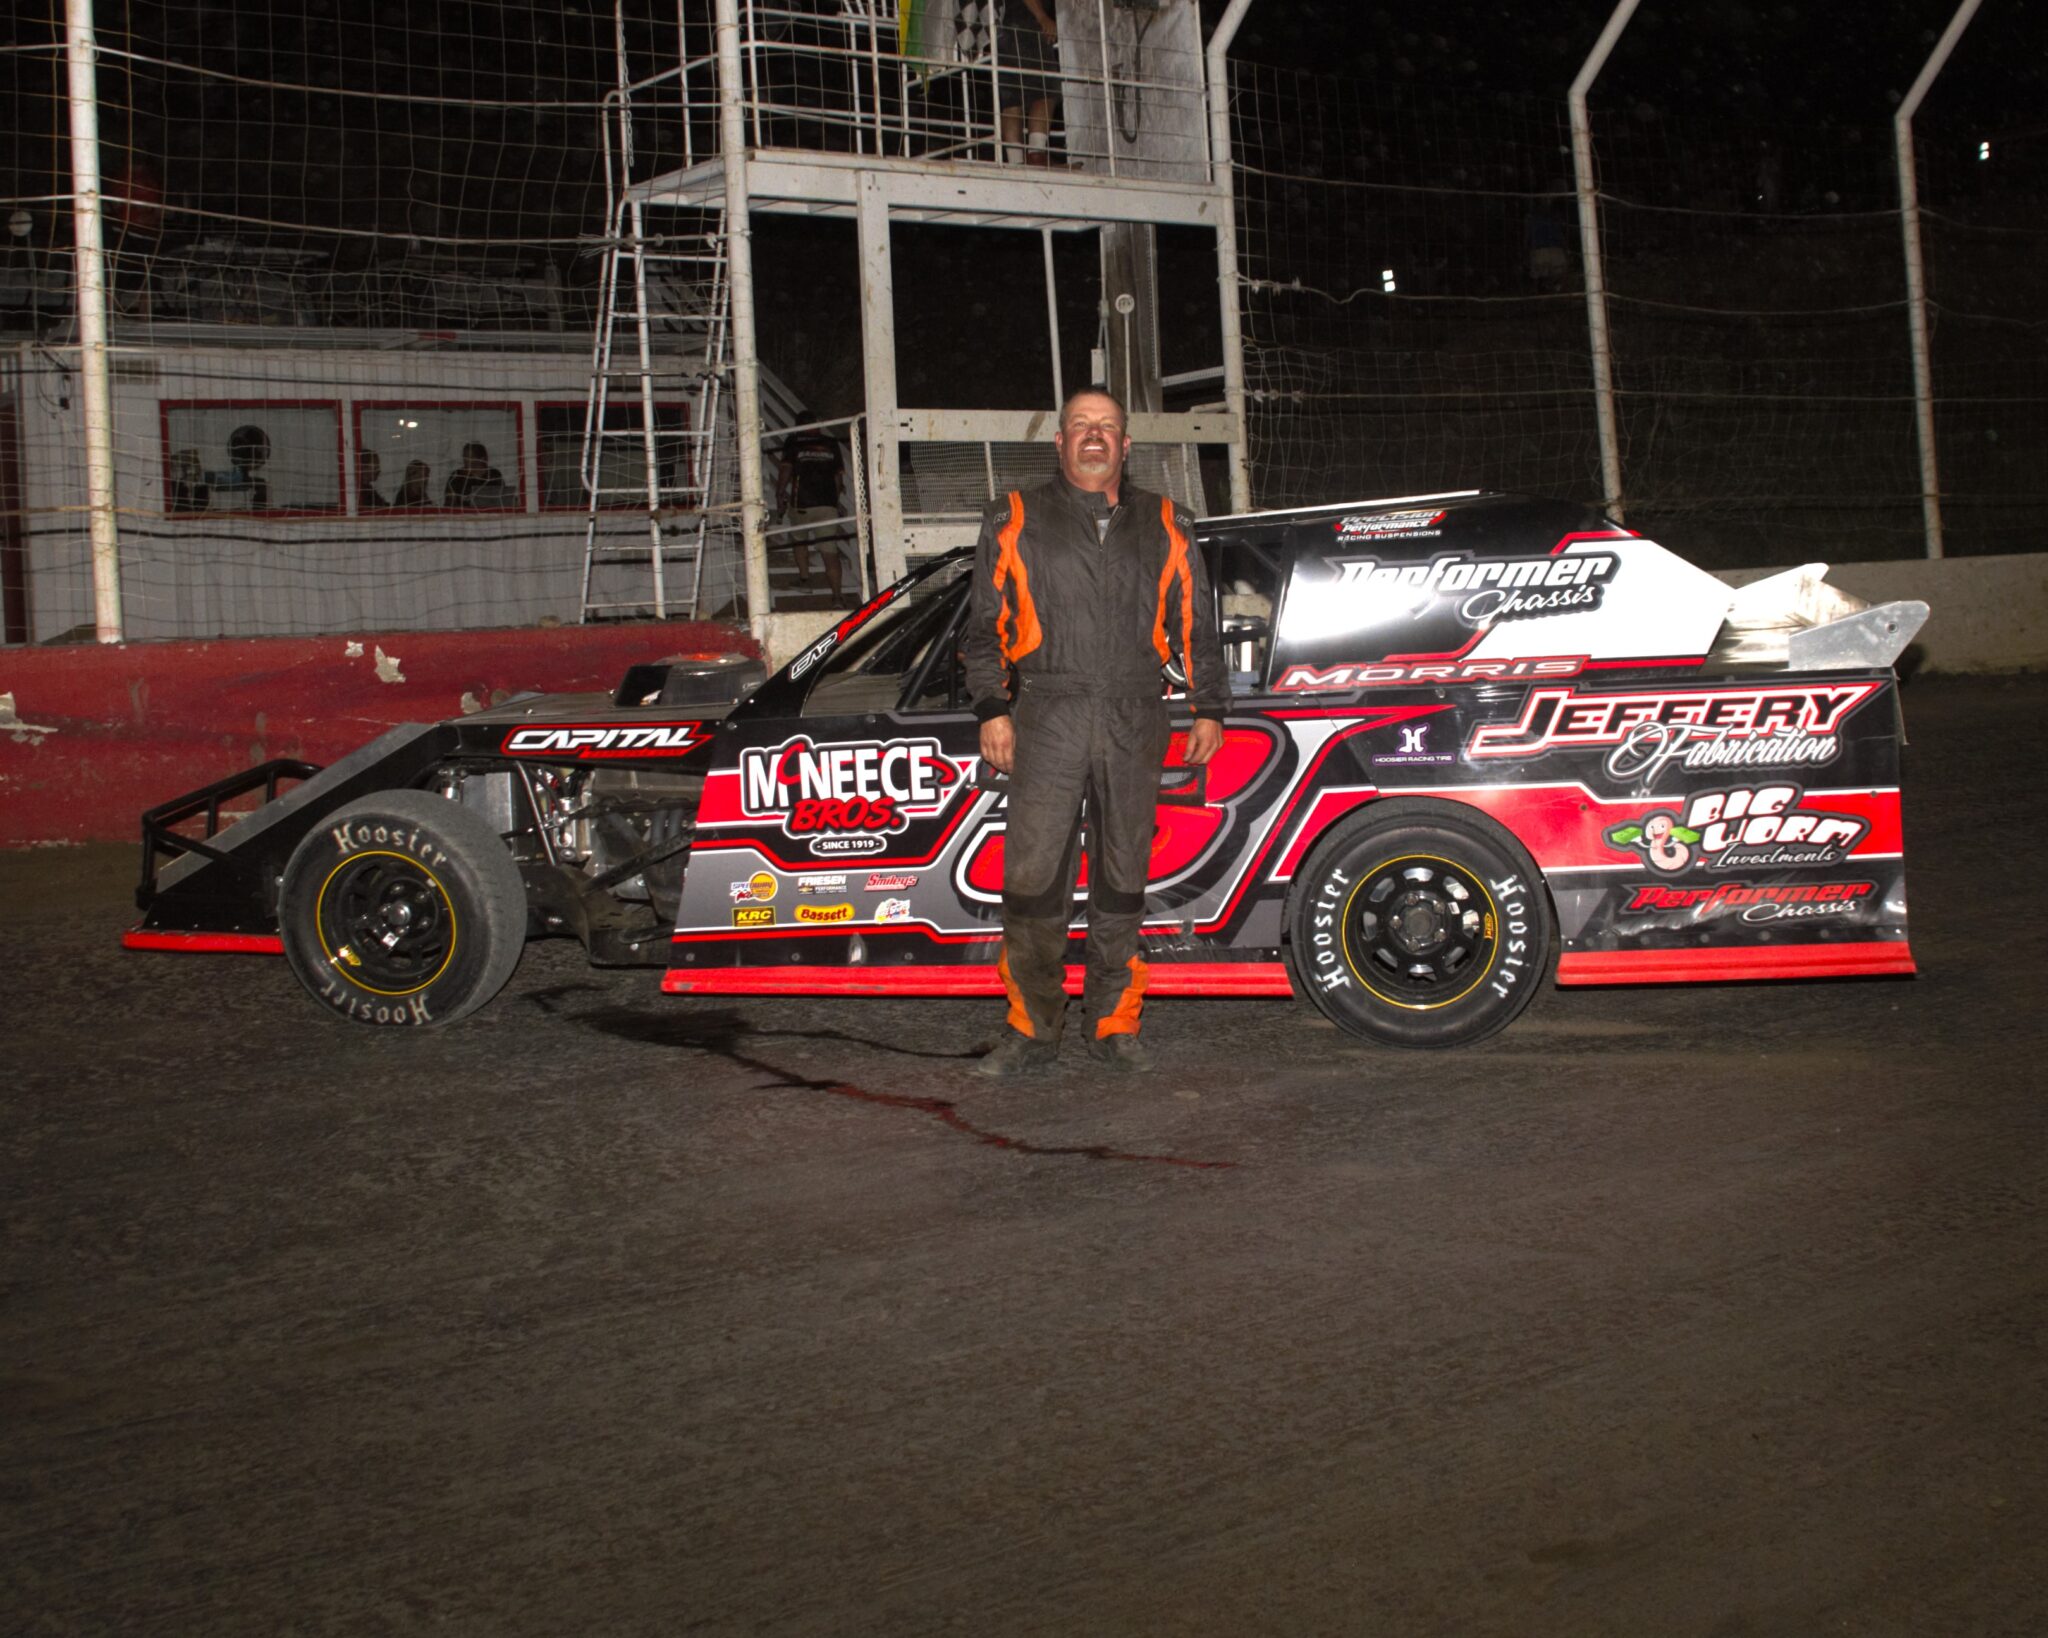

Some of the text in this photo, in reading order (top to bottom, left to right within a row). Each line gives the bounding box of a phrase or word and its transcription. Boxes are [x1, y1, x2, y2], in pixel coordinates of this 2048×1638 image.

[1337, 529, 1442, 543] RACING SUSPENSIONS
[1461, 584, 1596, 620] Chassis
[1283, 660, 1579, 687] MORRIS
[1469, 685, 1872, 756] JEFFERY
[508, 727, 695, 750] CAPITAL
[1607, 722, 1838, 784] Fabrication
[790, 795, 901, 831] BROS.
[1687, 787, 1796, 828] BIG
[333, 822, 447, 868] Hoosier
[822, 840, 874, 850] SINCE 1919
[1702, 815, 1863, 852] WORM
[1712, 841, 1836, 868] Investments
[798, 875, 847, 886] FRIESEN
[801, 907, 848, 921] Bassett
[1630, 883, 1873, 914] Performer
[1742, 900, 1856, 921] Chassis
[737, 910, 772, 921] KRC
[1313, 868, 1351, 992] Hoosier
[1490, 874, 1529, 998] Hoosier
[321, 980, 433, 1025] Hoosier
